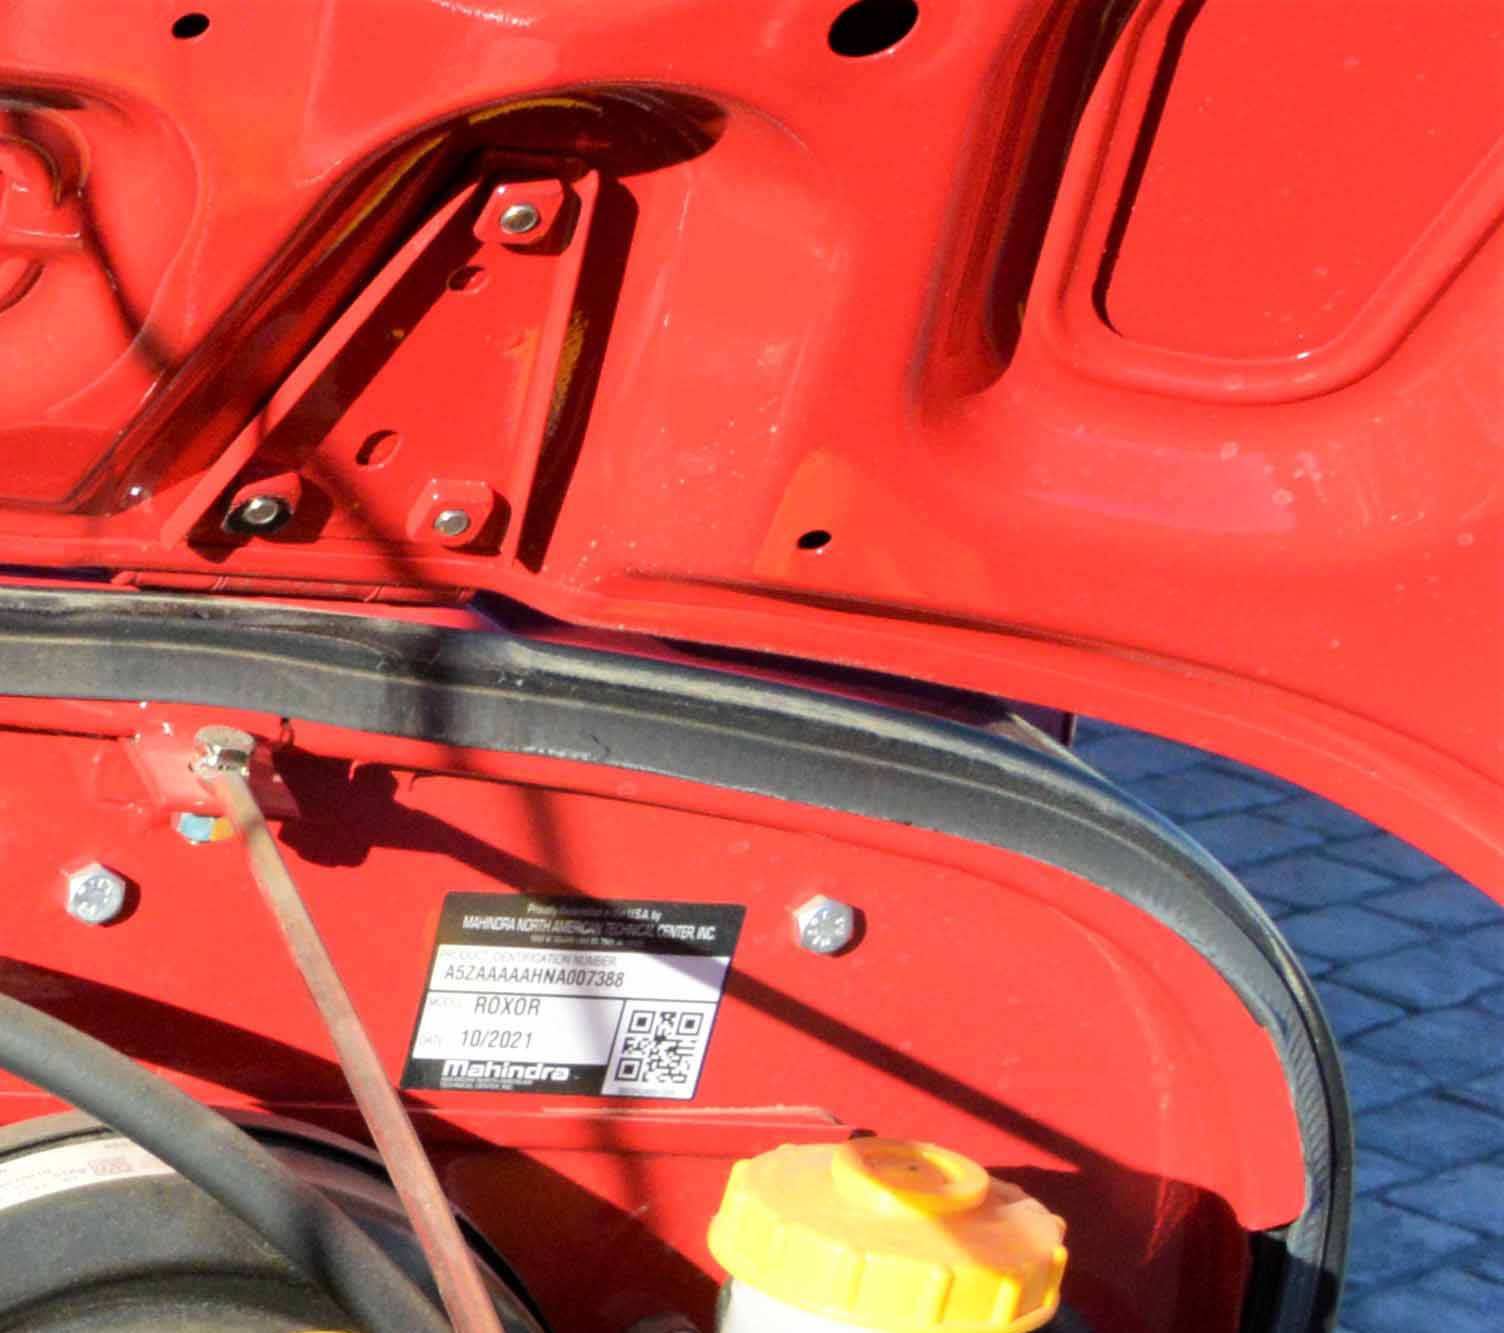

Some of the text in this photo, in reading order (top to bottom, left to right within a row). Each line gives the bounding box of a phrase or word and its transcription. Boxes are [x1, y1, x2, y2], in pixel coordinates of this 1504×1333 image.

[463, 915, 515, 931] MAHINDRA
[516, 916, 553, 932] NORTH
[474, 995, 541, 1016] ROXOR
[461, 1029, 533, 1050] 10/2021
